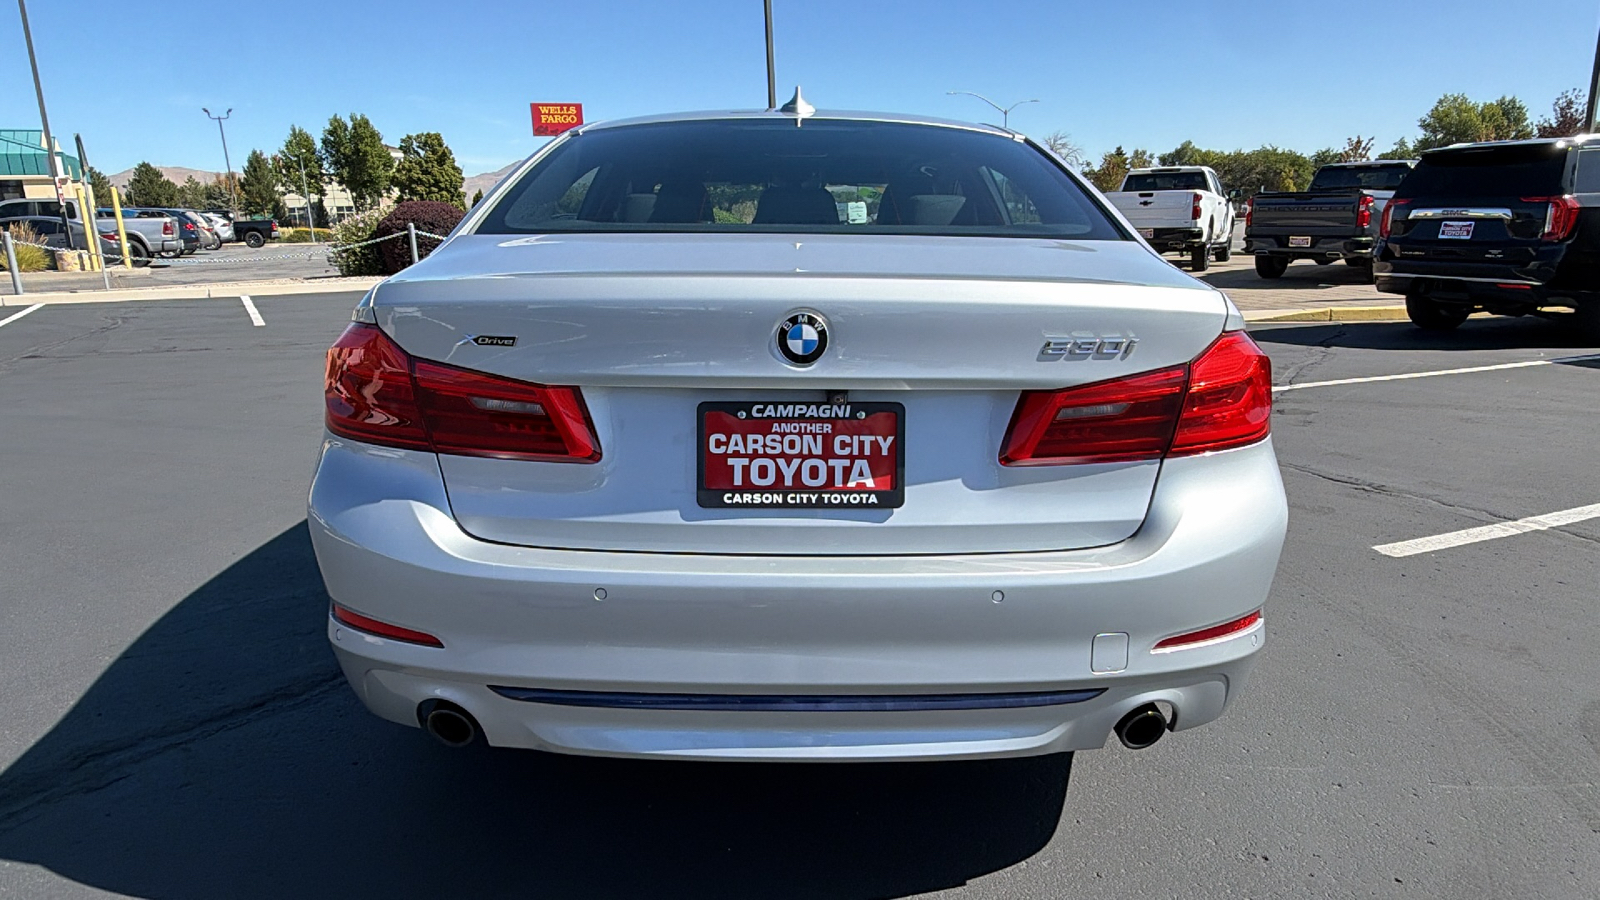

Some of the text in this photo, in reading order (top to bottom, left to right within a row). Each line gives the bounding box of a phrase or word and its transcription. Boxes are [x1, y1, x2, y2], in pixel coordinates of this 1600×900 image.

[539, 106, 577, 114] WELLS
[541, 115, 577, 123] FARGO
[782, 314, 825, 331] BMW
[751, 404, 851, 418] CAMPAGNI
[771, 422, 832, 433] ANOTHER
[708, 433, 895, 456] CARSON CITY
[727, 457, 876, 488] TOYOTA
[723, 493, 878, 504] CARSON CITY TOYOTA
